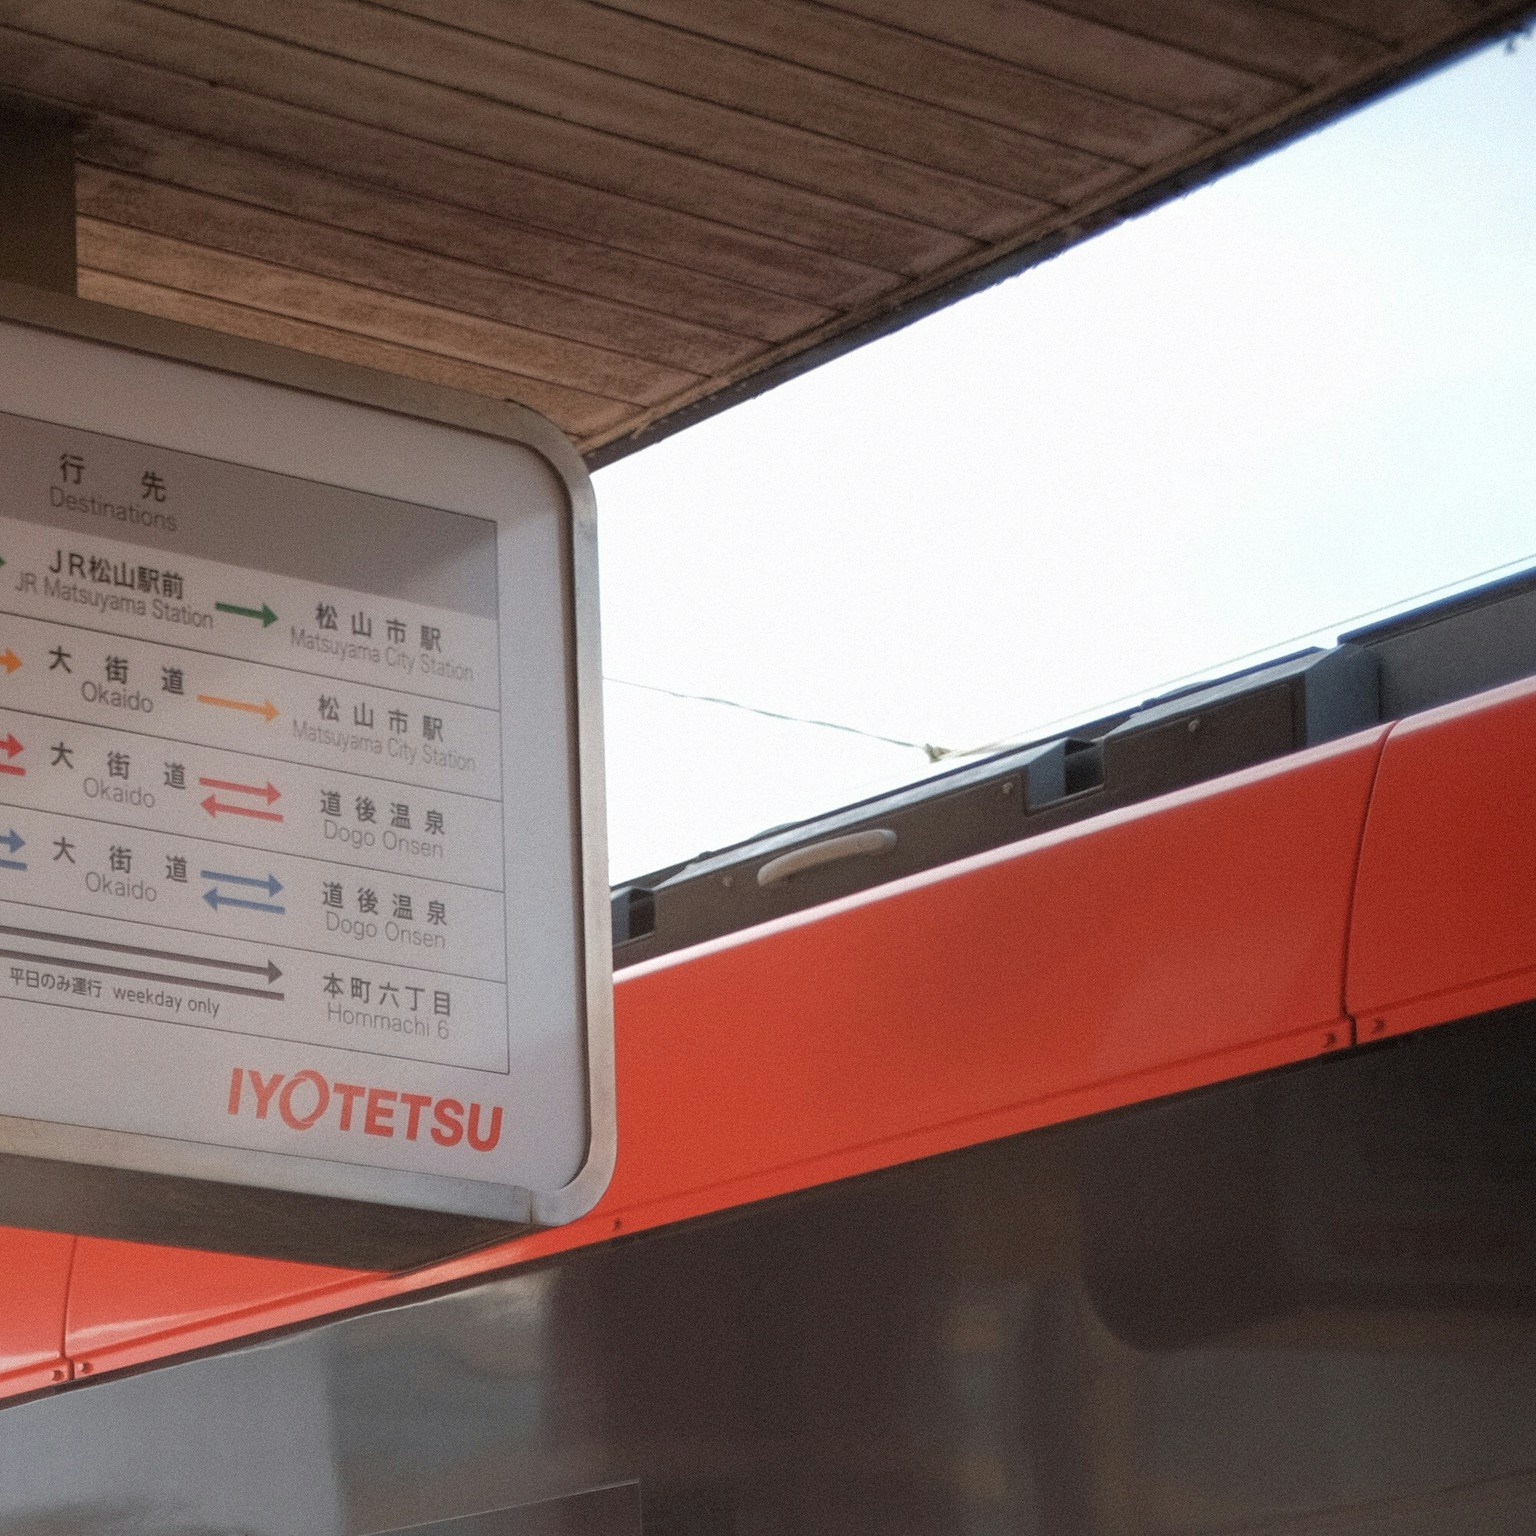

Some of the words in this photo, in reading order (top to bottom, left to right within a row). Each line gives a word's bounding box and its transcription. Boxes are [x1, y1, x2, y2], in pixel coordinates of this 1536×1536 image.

[48, 486, 178, 534] Destinations
[15, 570, 40, 595] JR
[42, 576, 147, 622] Matsuyama
[150, 597, 214, 631] Station
[289, 625, 381, 668] Matsuyama
[383, 644, 416, 676] City
[419, 651, 474, 683] Station
[80, 679, 155, 715] Okaido
[291, 718, 383, 761] Matsuyama
[384, 735, 418, 767] City
[420, 741, 476, 774] Station
[82, 776, 157, 810] Okaido
[323, 818, 376, 850] Dogo
[380, 828, 445, 860] Onsen
[84, 870, 159, 904] Okaido
[325, 910, 378, 941] Dogo
[383, 918, 447, 951] Onsen
[9, 966, 103, 1001] 平日のみ運行
[111, 983, 184, 1012] weekday
[186, 994, 221, 1019] only
[326, 1002, 432, 1040] Hommachi
[436, 1017, 450, 1042] 6
[226, 1066, 505, 1153] IYOTETSU
